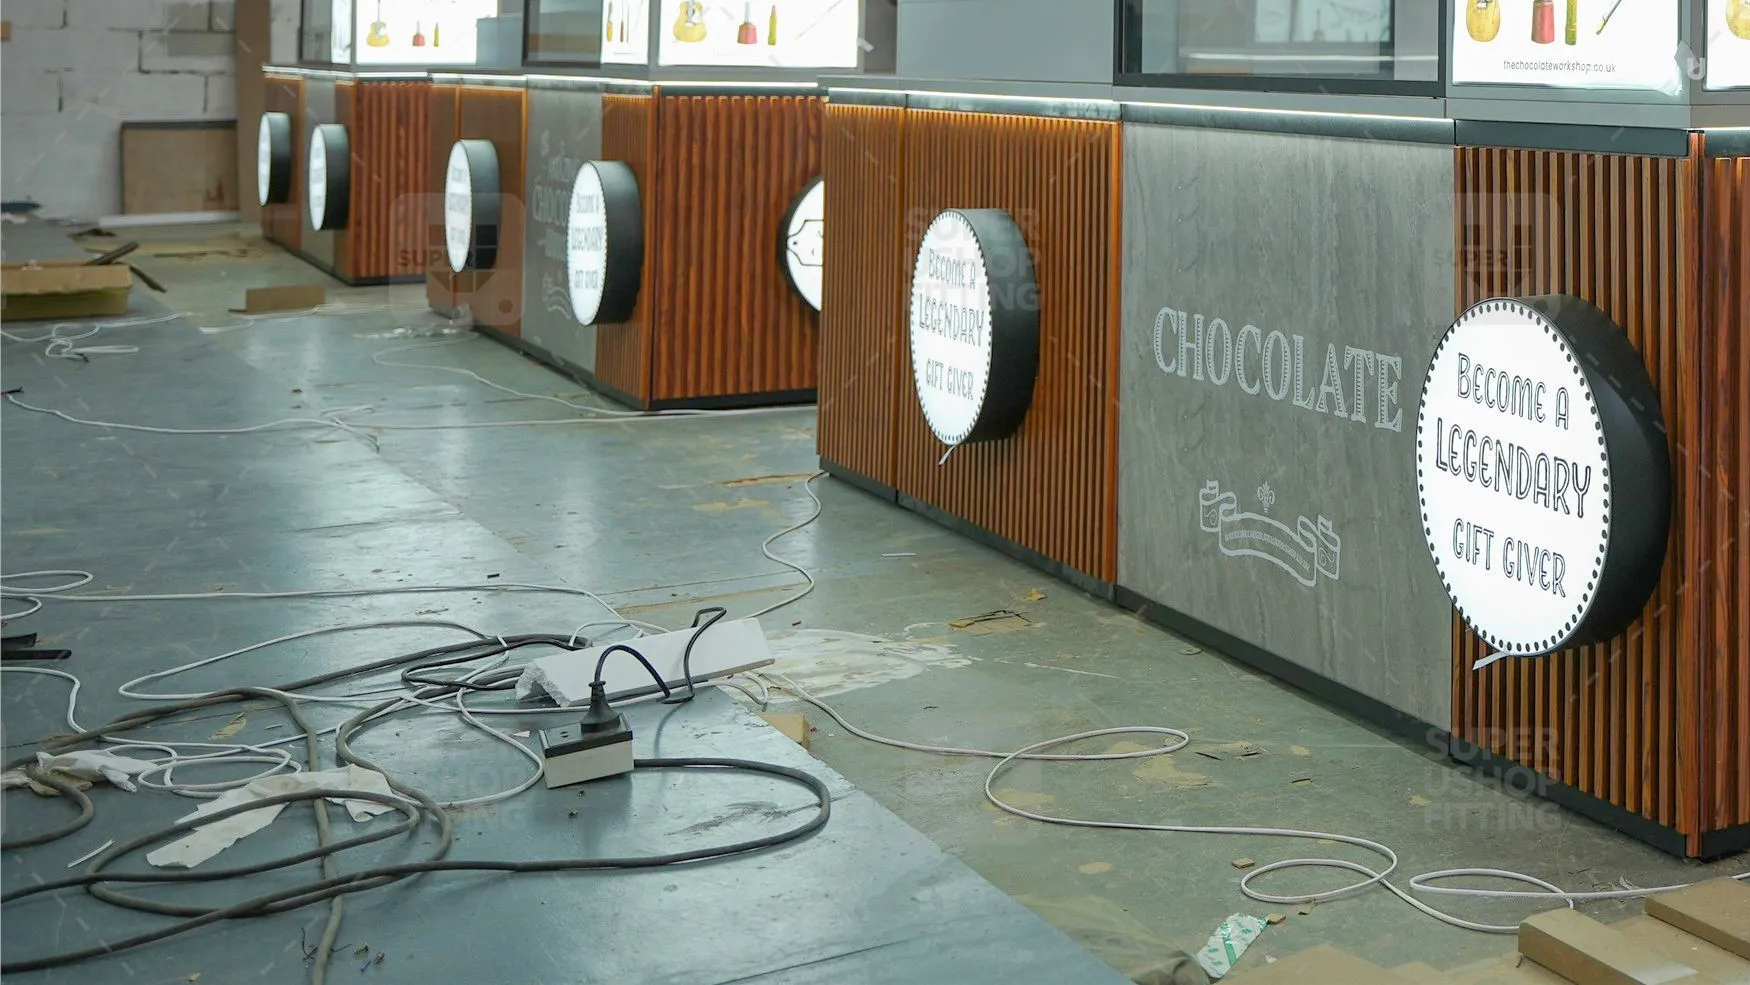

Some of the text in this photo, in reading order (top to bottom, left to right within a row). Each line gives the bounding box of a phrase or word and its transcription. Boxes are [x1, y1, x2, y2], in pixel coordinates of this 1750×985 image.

[1503, 60, 1617, 75] thechocolateworkshop.co.uk
[919, 293, 985, 347] LEGENDARY
[926, 358, 974, 400] GIFT GIVER
[1153, 306, 1402, 433] CHOCOLATE
[1556, 387, 1569, 430] A
[1436, 417, 1591, 518] LEGENDARY
[1453, 518, 1566, 598] GIFT GIVER
